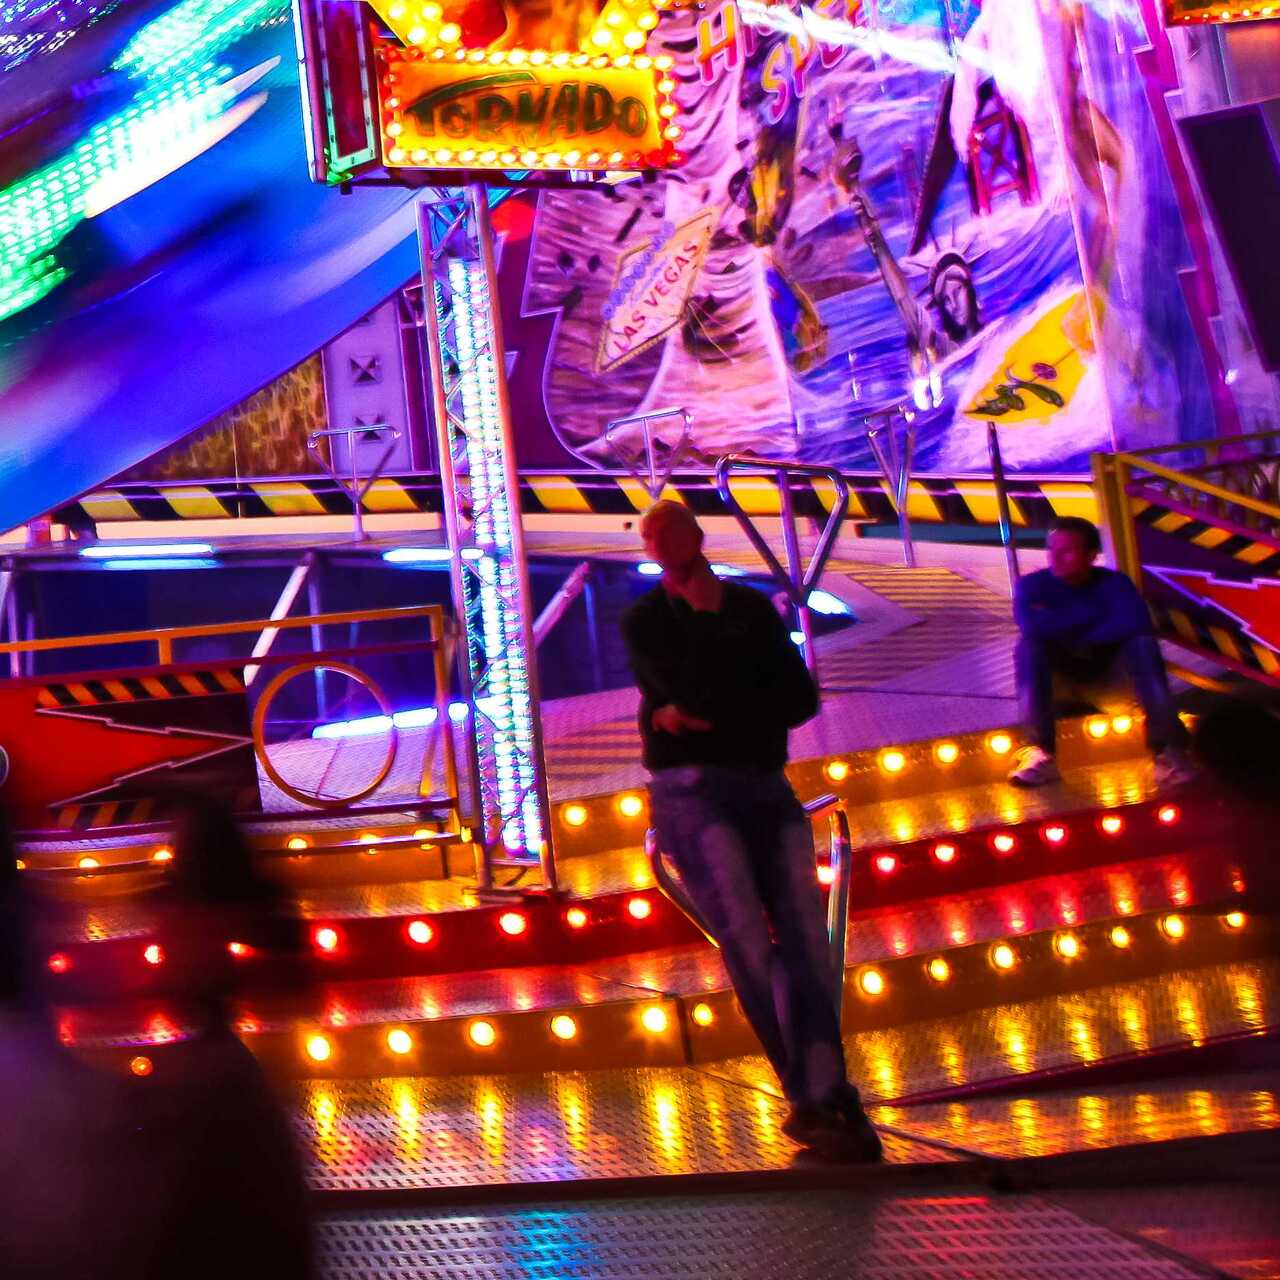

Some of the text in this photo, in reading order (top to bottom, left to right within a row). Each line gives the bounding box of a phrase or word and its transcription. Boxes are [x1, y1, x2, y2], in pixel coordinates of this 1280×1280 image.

[402, 71, 648, 148] TORNADO
[614, 310, 648, 352] LAS
[643, 242, 698, 308] VEGAS
